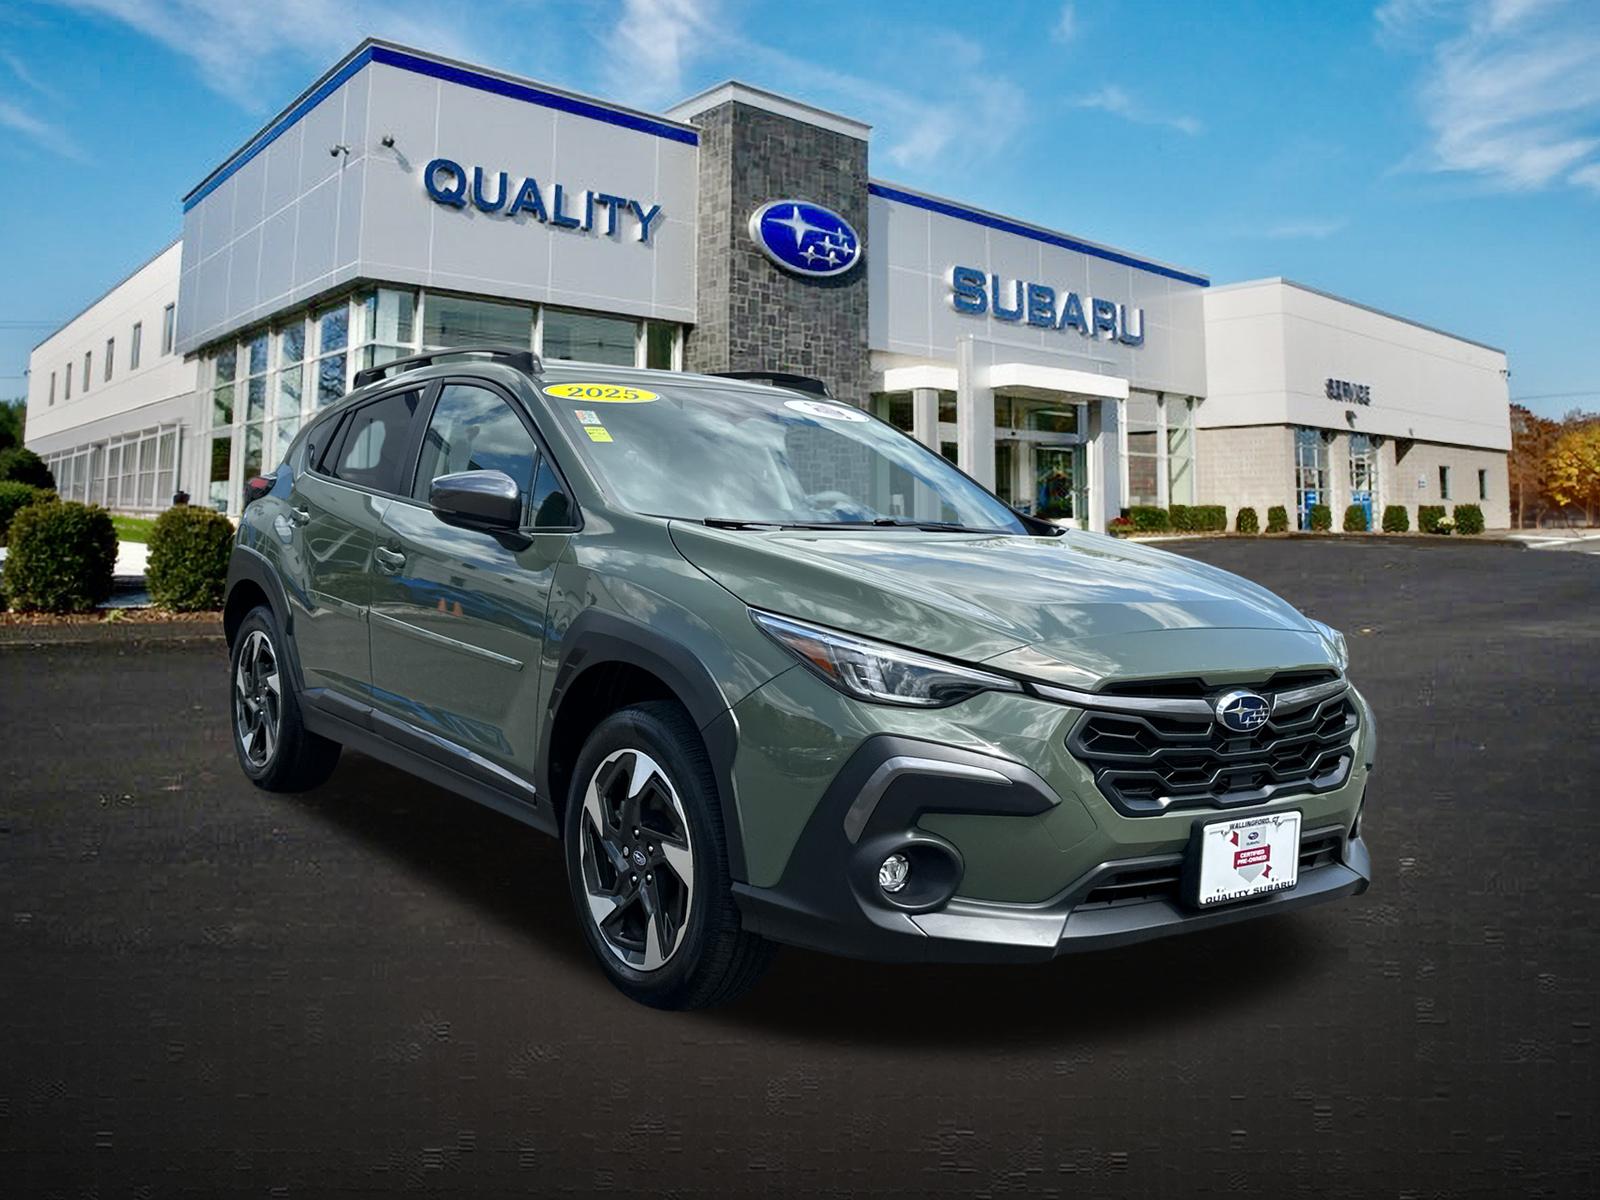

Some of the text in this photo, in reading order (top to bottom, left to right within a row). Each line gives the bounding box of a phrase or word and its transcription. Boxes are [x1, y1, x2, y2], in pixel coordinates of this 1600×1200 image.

[424, 158, 661, 242] QUALITY
[952, 265, 1145, 346] SUBARU
[567, 385, 639, 401] 2025
[1237, 855, 1267, 865] PRE-OWNED
[1240, 849, 1265, 858] CERTIFIED
[1205, 880, 1294, 904] QUALITY SUBARU
